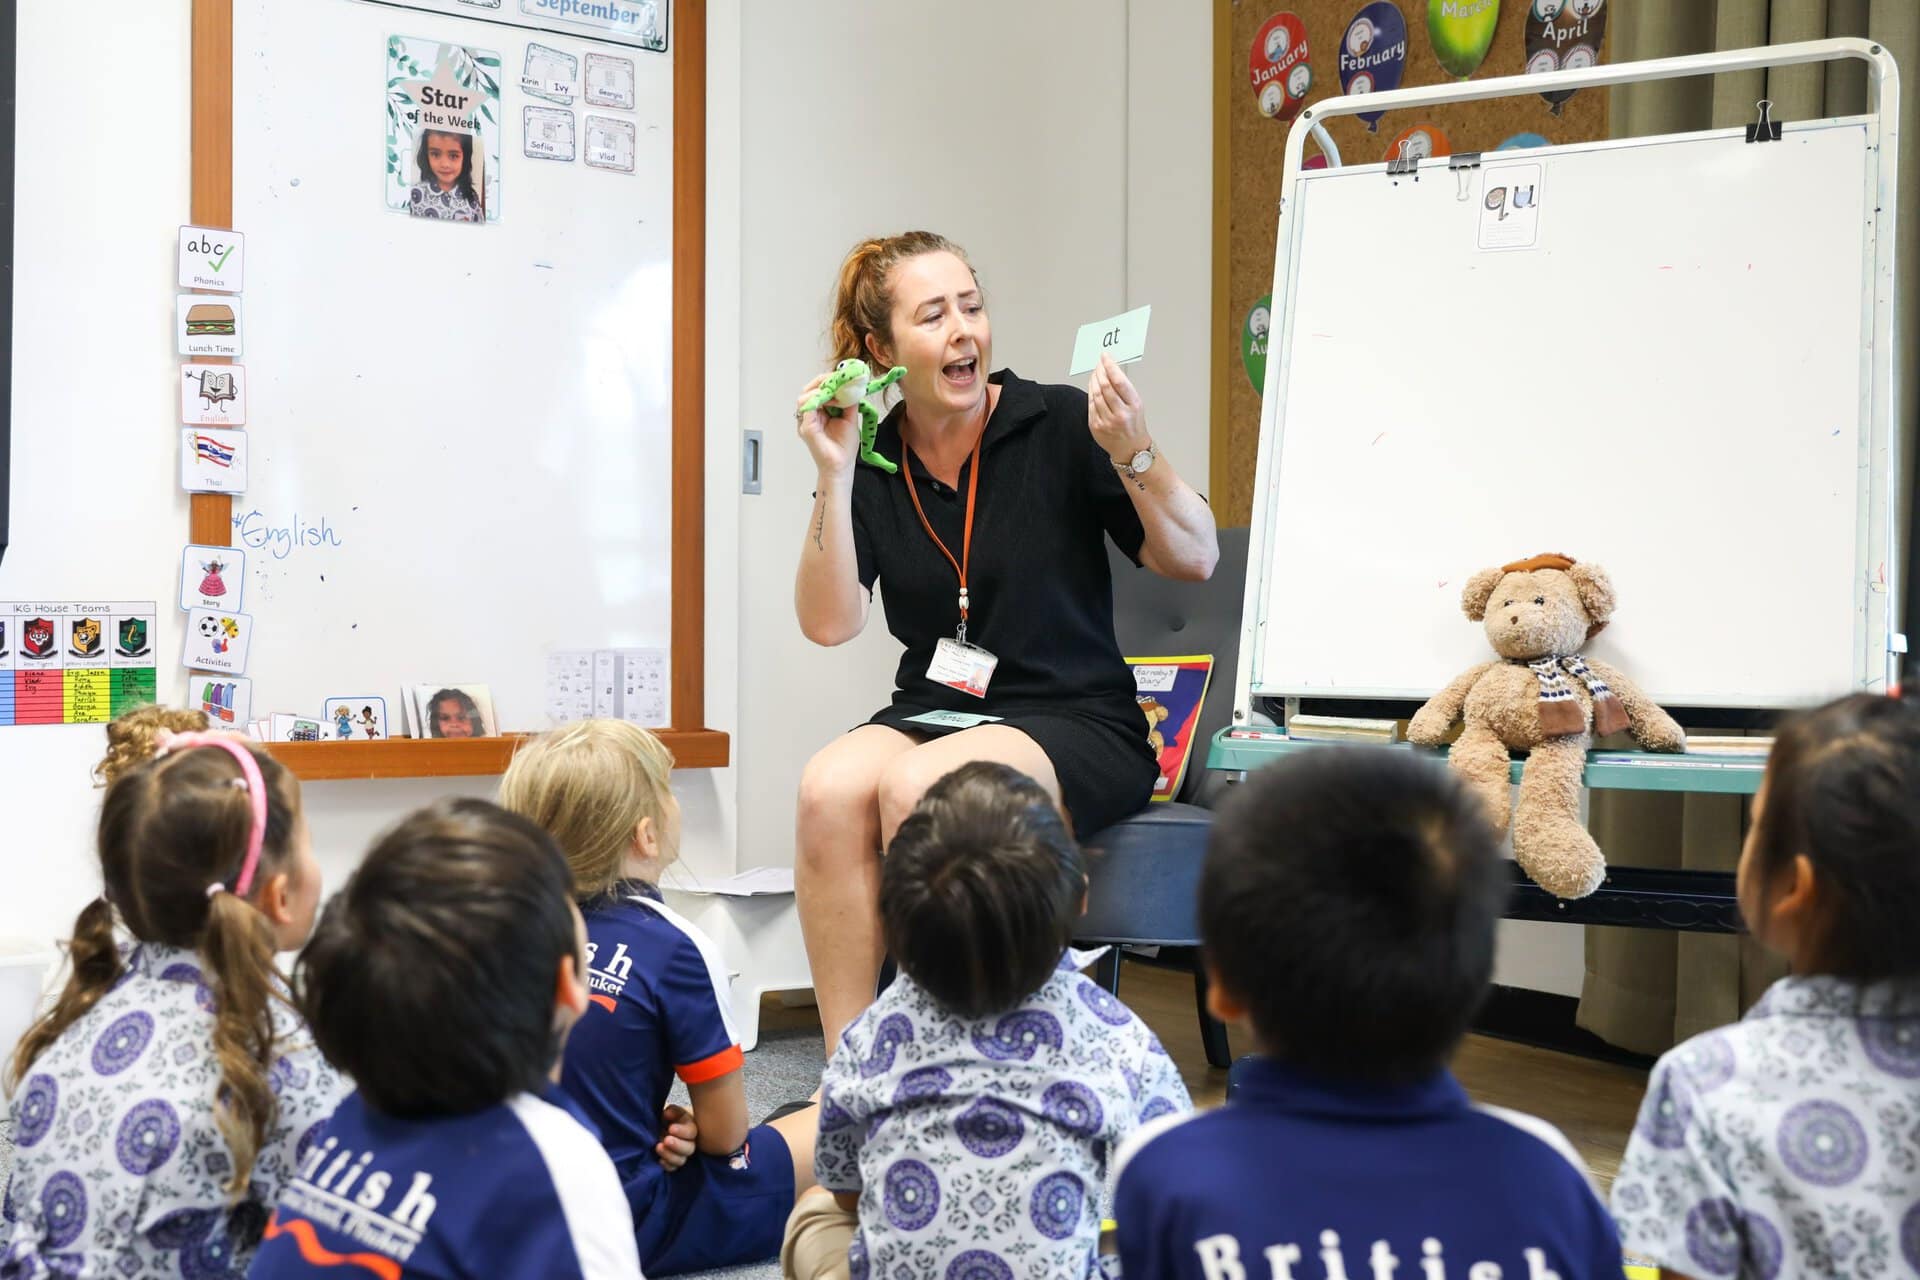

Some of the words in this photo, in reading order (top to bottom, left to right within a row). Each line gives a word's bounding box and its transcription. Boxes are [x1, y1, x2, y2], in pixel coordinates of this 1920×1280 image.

[1542, 18, 1588, 48] April
[1341, 40, 1405, 71] February
[1253, 40, 1308, 85] January
[554, 83, 568, 94] Ivy
[421, 86, 468, 109] Star
[407, 109, 420, 124] of
[424, 112, 443, 125] the
[448, 115, 480, 130] Week
[599, 152, 615, 161] Vlad
[187, 234, 224, 256] abc
[194, 276, 224, 287] Phonics
[1103, 327, 1120, 347] at
[188, 344, 213, 353] Lunch
[215, 345, 235, 353] Time
[200, 414, 230, 424] English
[35, 604, 69, 613] House
[74, 604, 111, 613] Teams
[203, 600, 220, 608] Story
[195, 656, 232, 667] Activities
[1139, 677, 1161, 687] Diary
[586, 976, 623, 996] uket
